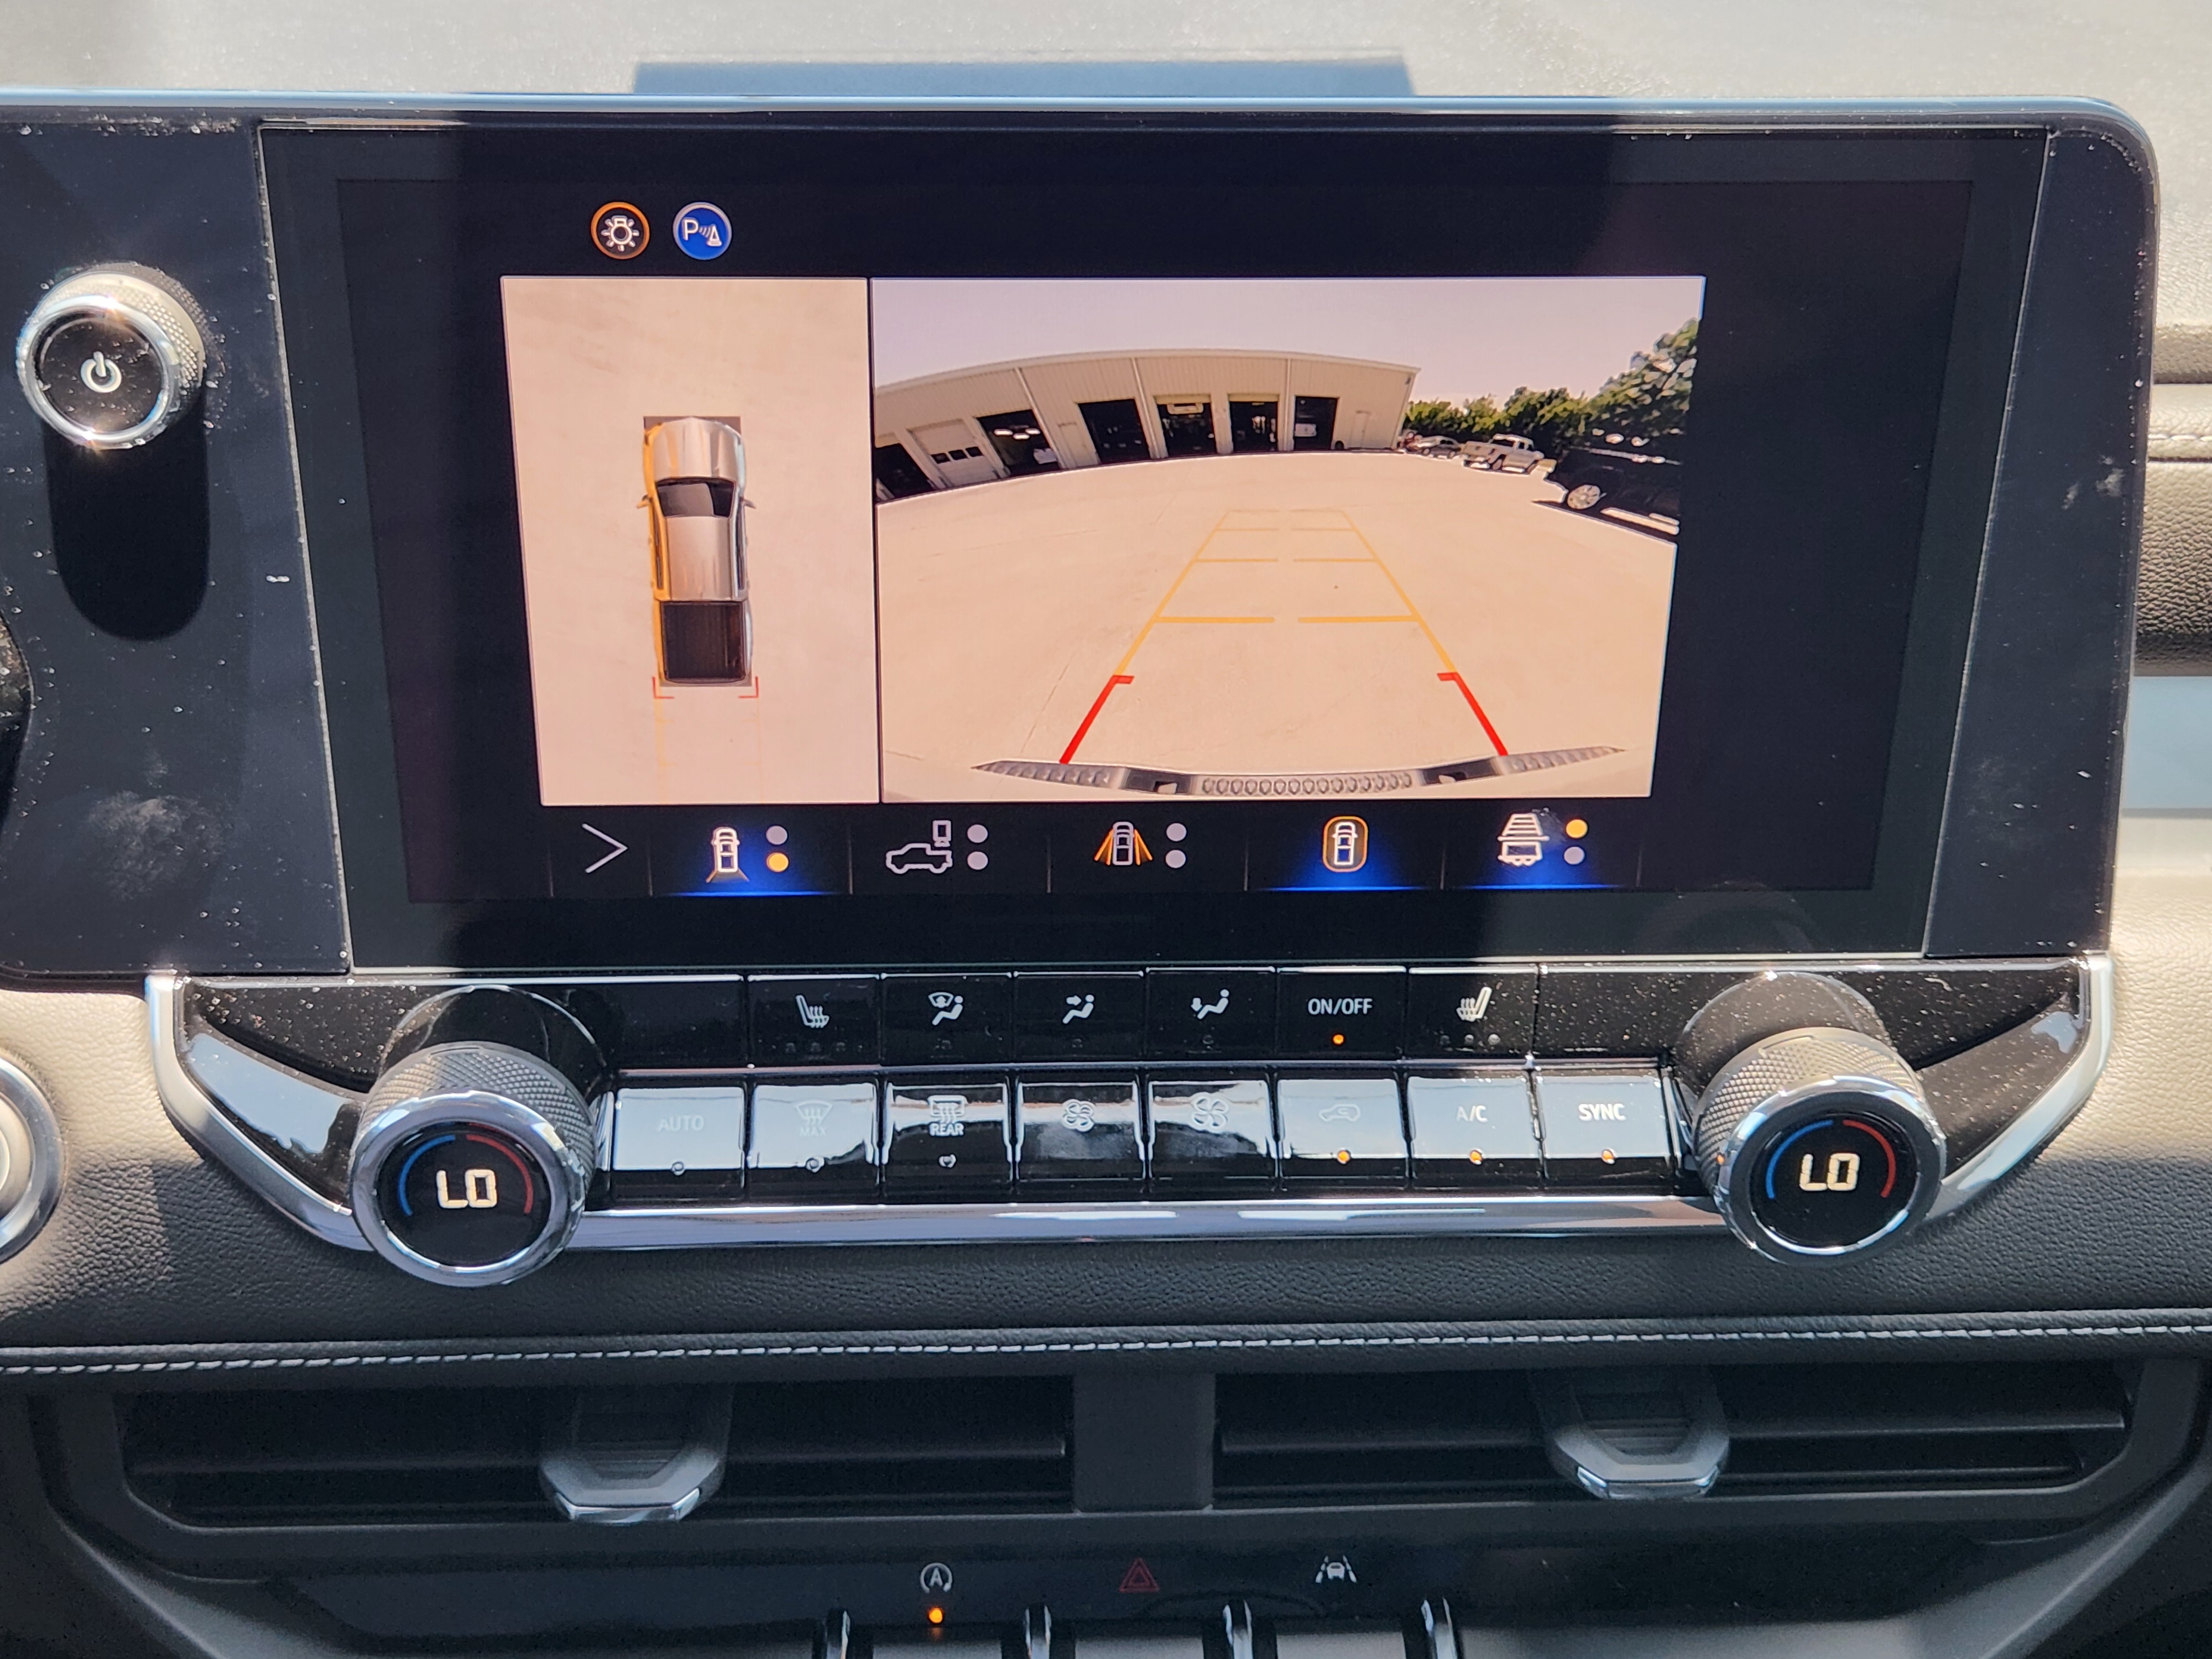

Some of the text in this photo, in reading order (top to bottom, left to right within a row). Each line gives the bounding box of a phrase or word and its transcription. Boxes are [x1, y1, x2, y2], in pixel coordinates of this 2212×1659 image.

[1308, 998, 1373, 1015] ON/OFF
[1456, 1105, 1488, 1123] A/C
[1578, 1103, 1626, 1121] SYNC
[658, 1115, 705, 1132] AUTO
[800, 1125, 827, 1138] MAX
[929, 1123, 964, 1137] REAR
[1799, 1153, 1860, 1191] LO
[436, 1168, 498, 1209] LO
